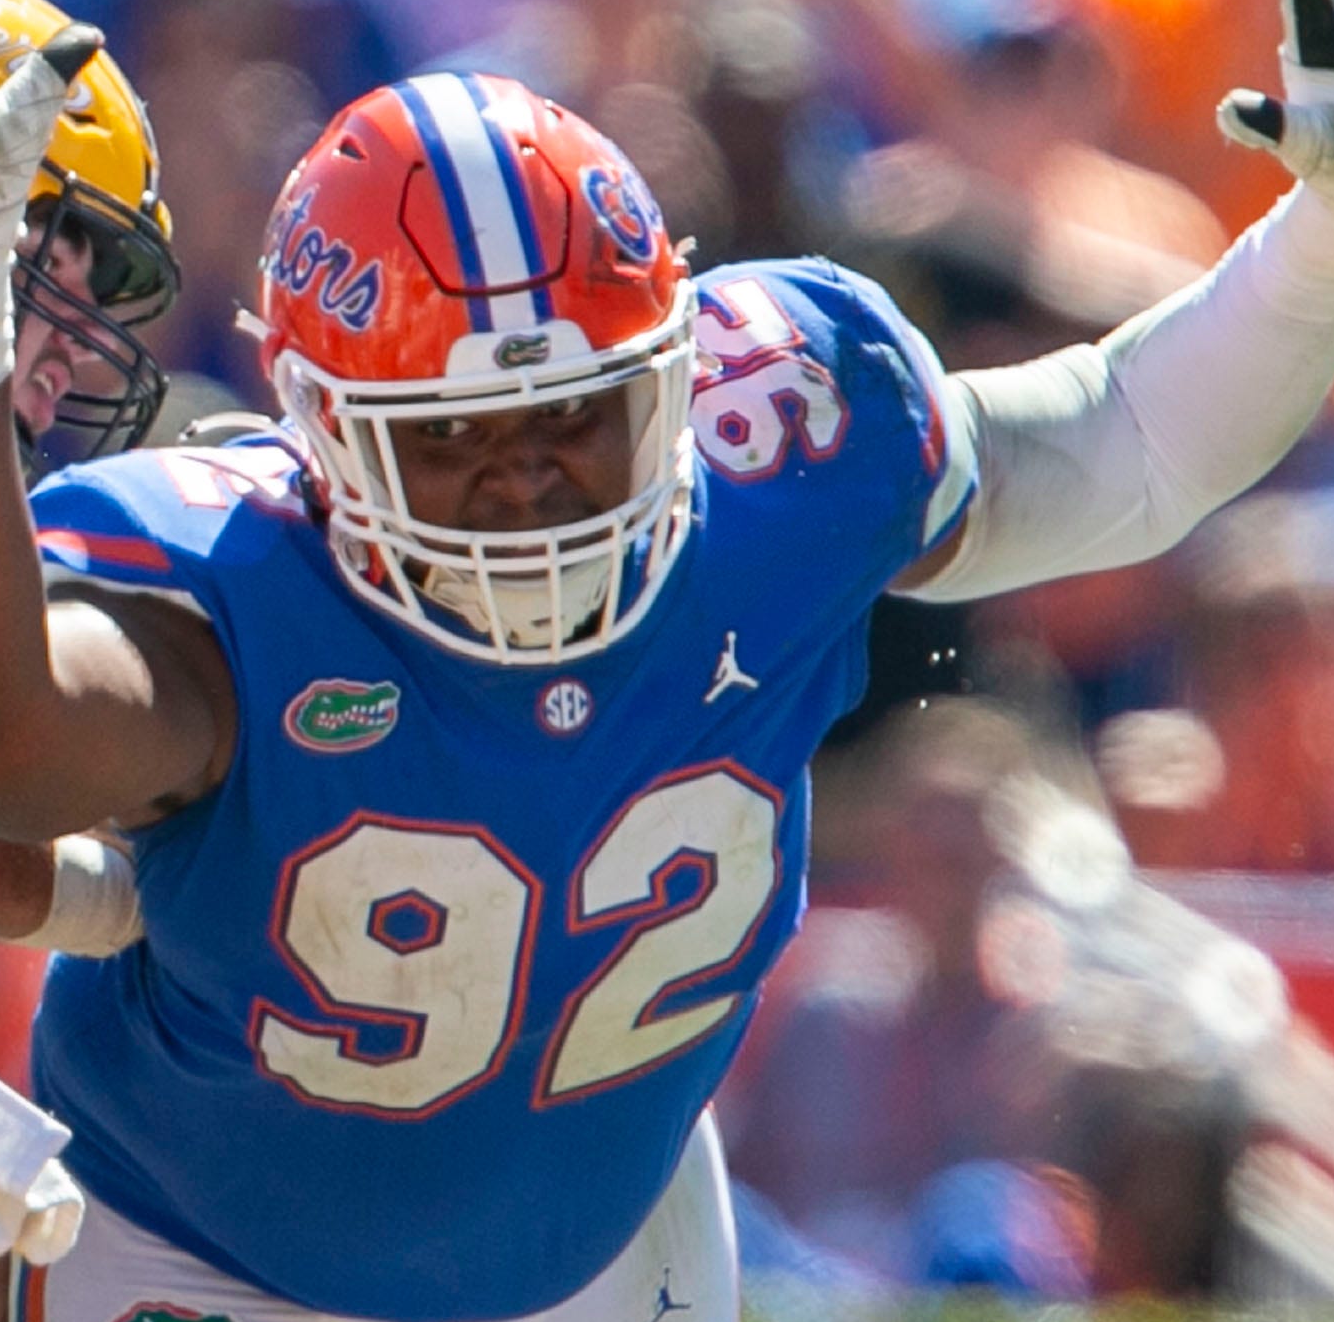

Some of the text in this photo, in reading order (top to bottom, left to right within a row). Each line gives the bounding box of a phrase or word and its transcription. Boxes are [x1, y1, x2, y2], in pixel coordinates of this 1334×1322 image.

[268, 185, 384, 333] tors
[545, 683, 590, 730] SEC
[247, 757, 783, 1121] 92
